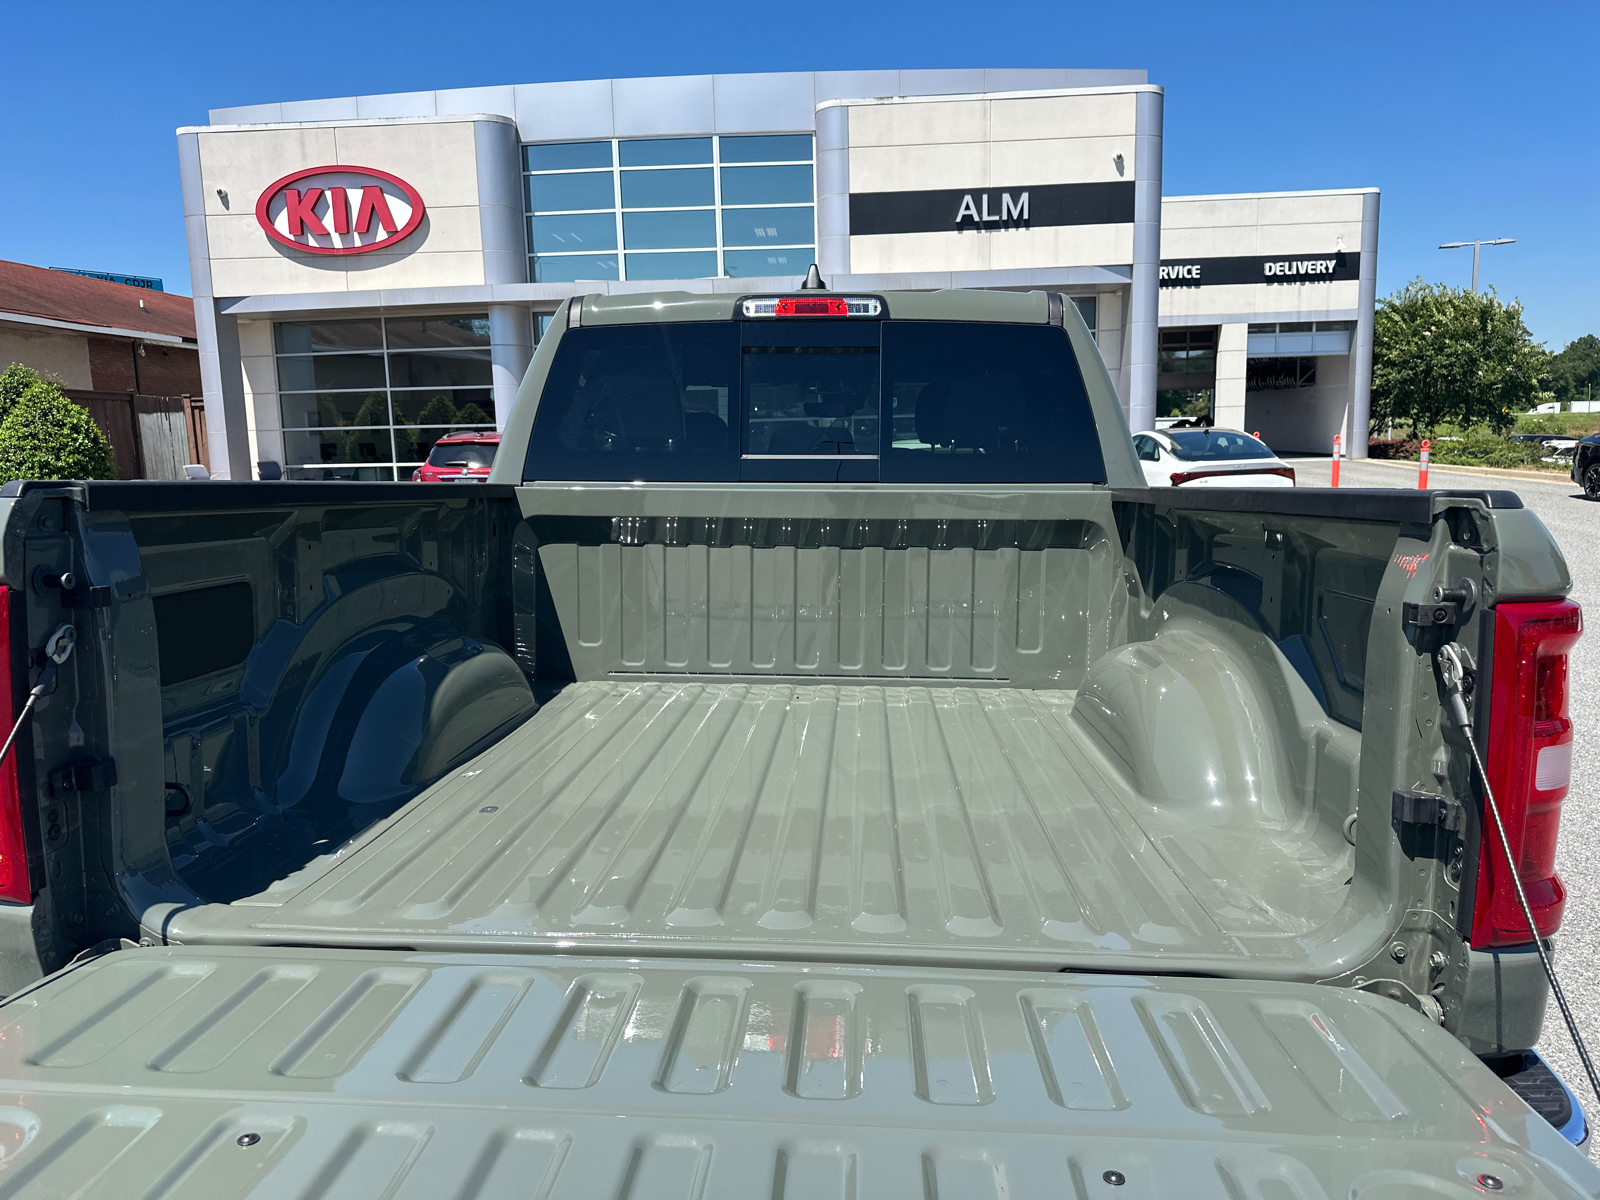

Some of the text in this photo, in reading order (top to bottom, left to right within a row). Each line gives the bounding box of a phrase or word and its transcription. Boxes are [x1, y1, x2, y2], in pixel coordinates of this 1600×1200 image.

[283, 186, 398, 235] KIA
[955, 192, 1029, 223] ALM
[1264, 259, 1337, 276] DELIVERY
[125, 278, 154, 290] CDJR
